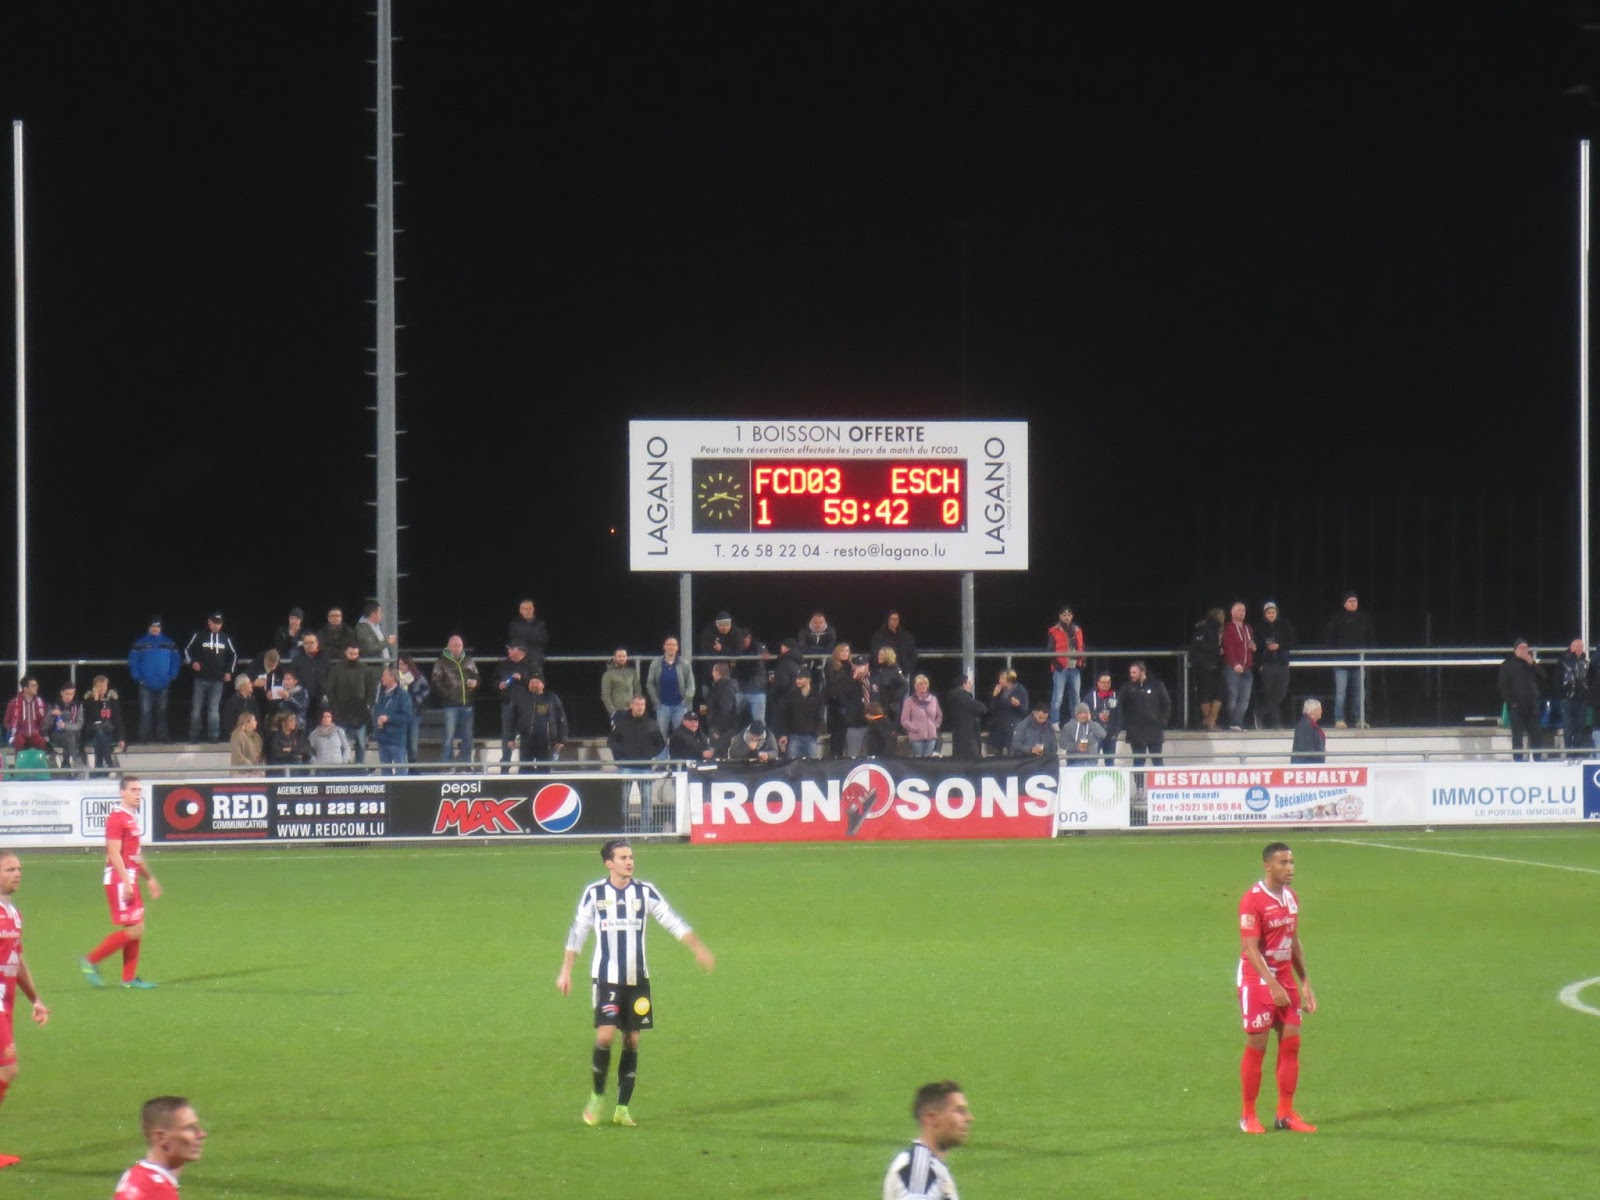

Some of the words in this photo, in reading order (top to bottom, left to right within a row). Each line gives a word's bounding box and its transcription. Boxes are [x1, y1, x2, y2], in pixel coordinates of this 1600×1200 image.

[735, 425, 742, 442] 1
[752, 425, 840, 442] BOISSON
[848, 425, 925, 442] OFFERTE
[700, 445, 720, 454] Pour
[722, 445, 744, 454] toute
[747, 445, 795, 454] réservation
[797, 445, 836, 454] effectuée
[838, 445, 850, 454] les
[852, 445, 874, 456] jours
[876, 445, 887, 454] de
[889, 445, 915, 454] match
[917, 445, 928, 454] du
[930, 445, 959, 454] FCD03
[755, 468, 842, 494] FCD03
[891, 468, 960, 494] ESCH
[646, 436, 668, 556] LAGANO
[984, 437, 1005, 555] LAGANO
[757, 499, 772, 525] 1
[823, 499, 910, 525] 59:42
[942, 499, 960, 525] 0
[714, 544, 725, 557] T.
[731, 544, 750, 557] 26
[754, 544, 773, 557] 58
[778, 544, 797, 557] 22
[801, 544, 821, 557] 04
[833, 543, 947, 560] resto@lagano.lu
[1154, 771, 1274, 786] RESTAURANT
[1283, 770, 1360, 784] PENALTY
[276, 786, 303, 795] AGENCE
[302, 786, 319, 795] WEB
[325, 785, 349, 794] STUDIO
[349, 784, 386, 794] GRAPHIQUE
[441, 780, 482, 796] pepsi
[1151, 791, 1180, 800] Fermé
[1182, 791, 1190, 799] le
[1193, 791, 1220, 799] mardi
[1432, 786, 1576, 805] IMMOTOP.LU
[212, 795, 268, 819] RED
[689, 780, 841, 825] IRON
[895, 774, 1058, 820] SONS
[276, 803, 291, 816] T.
[295, 803, 322, 815] 691
[327, 802, 355, 815] 225
[359, 801, 386, 814] 281
[432, 797, 529, 836] MAX
[1475, 808, 1485, 817] LE
[1488, 807, 1524, 816] PORTAIL
[1526, 807, 1577, 816] IMMOBILIER
[212, 819, 268, 830] COMMUNICATION
[276, 822, 385, 837] WWW.REDCOM.LU
